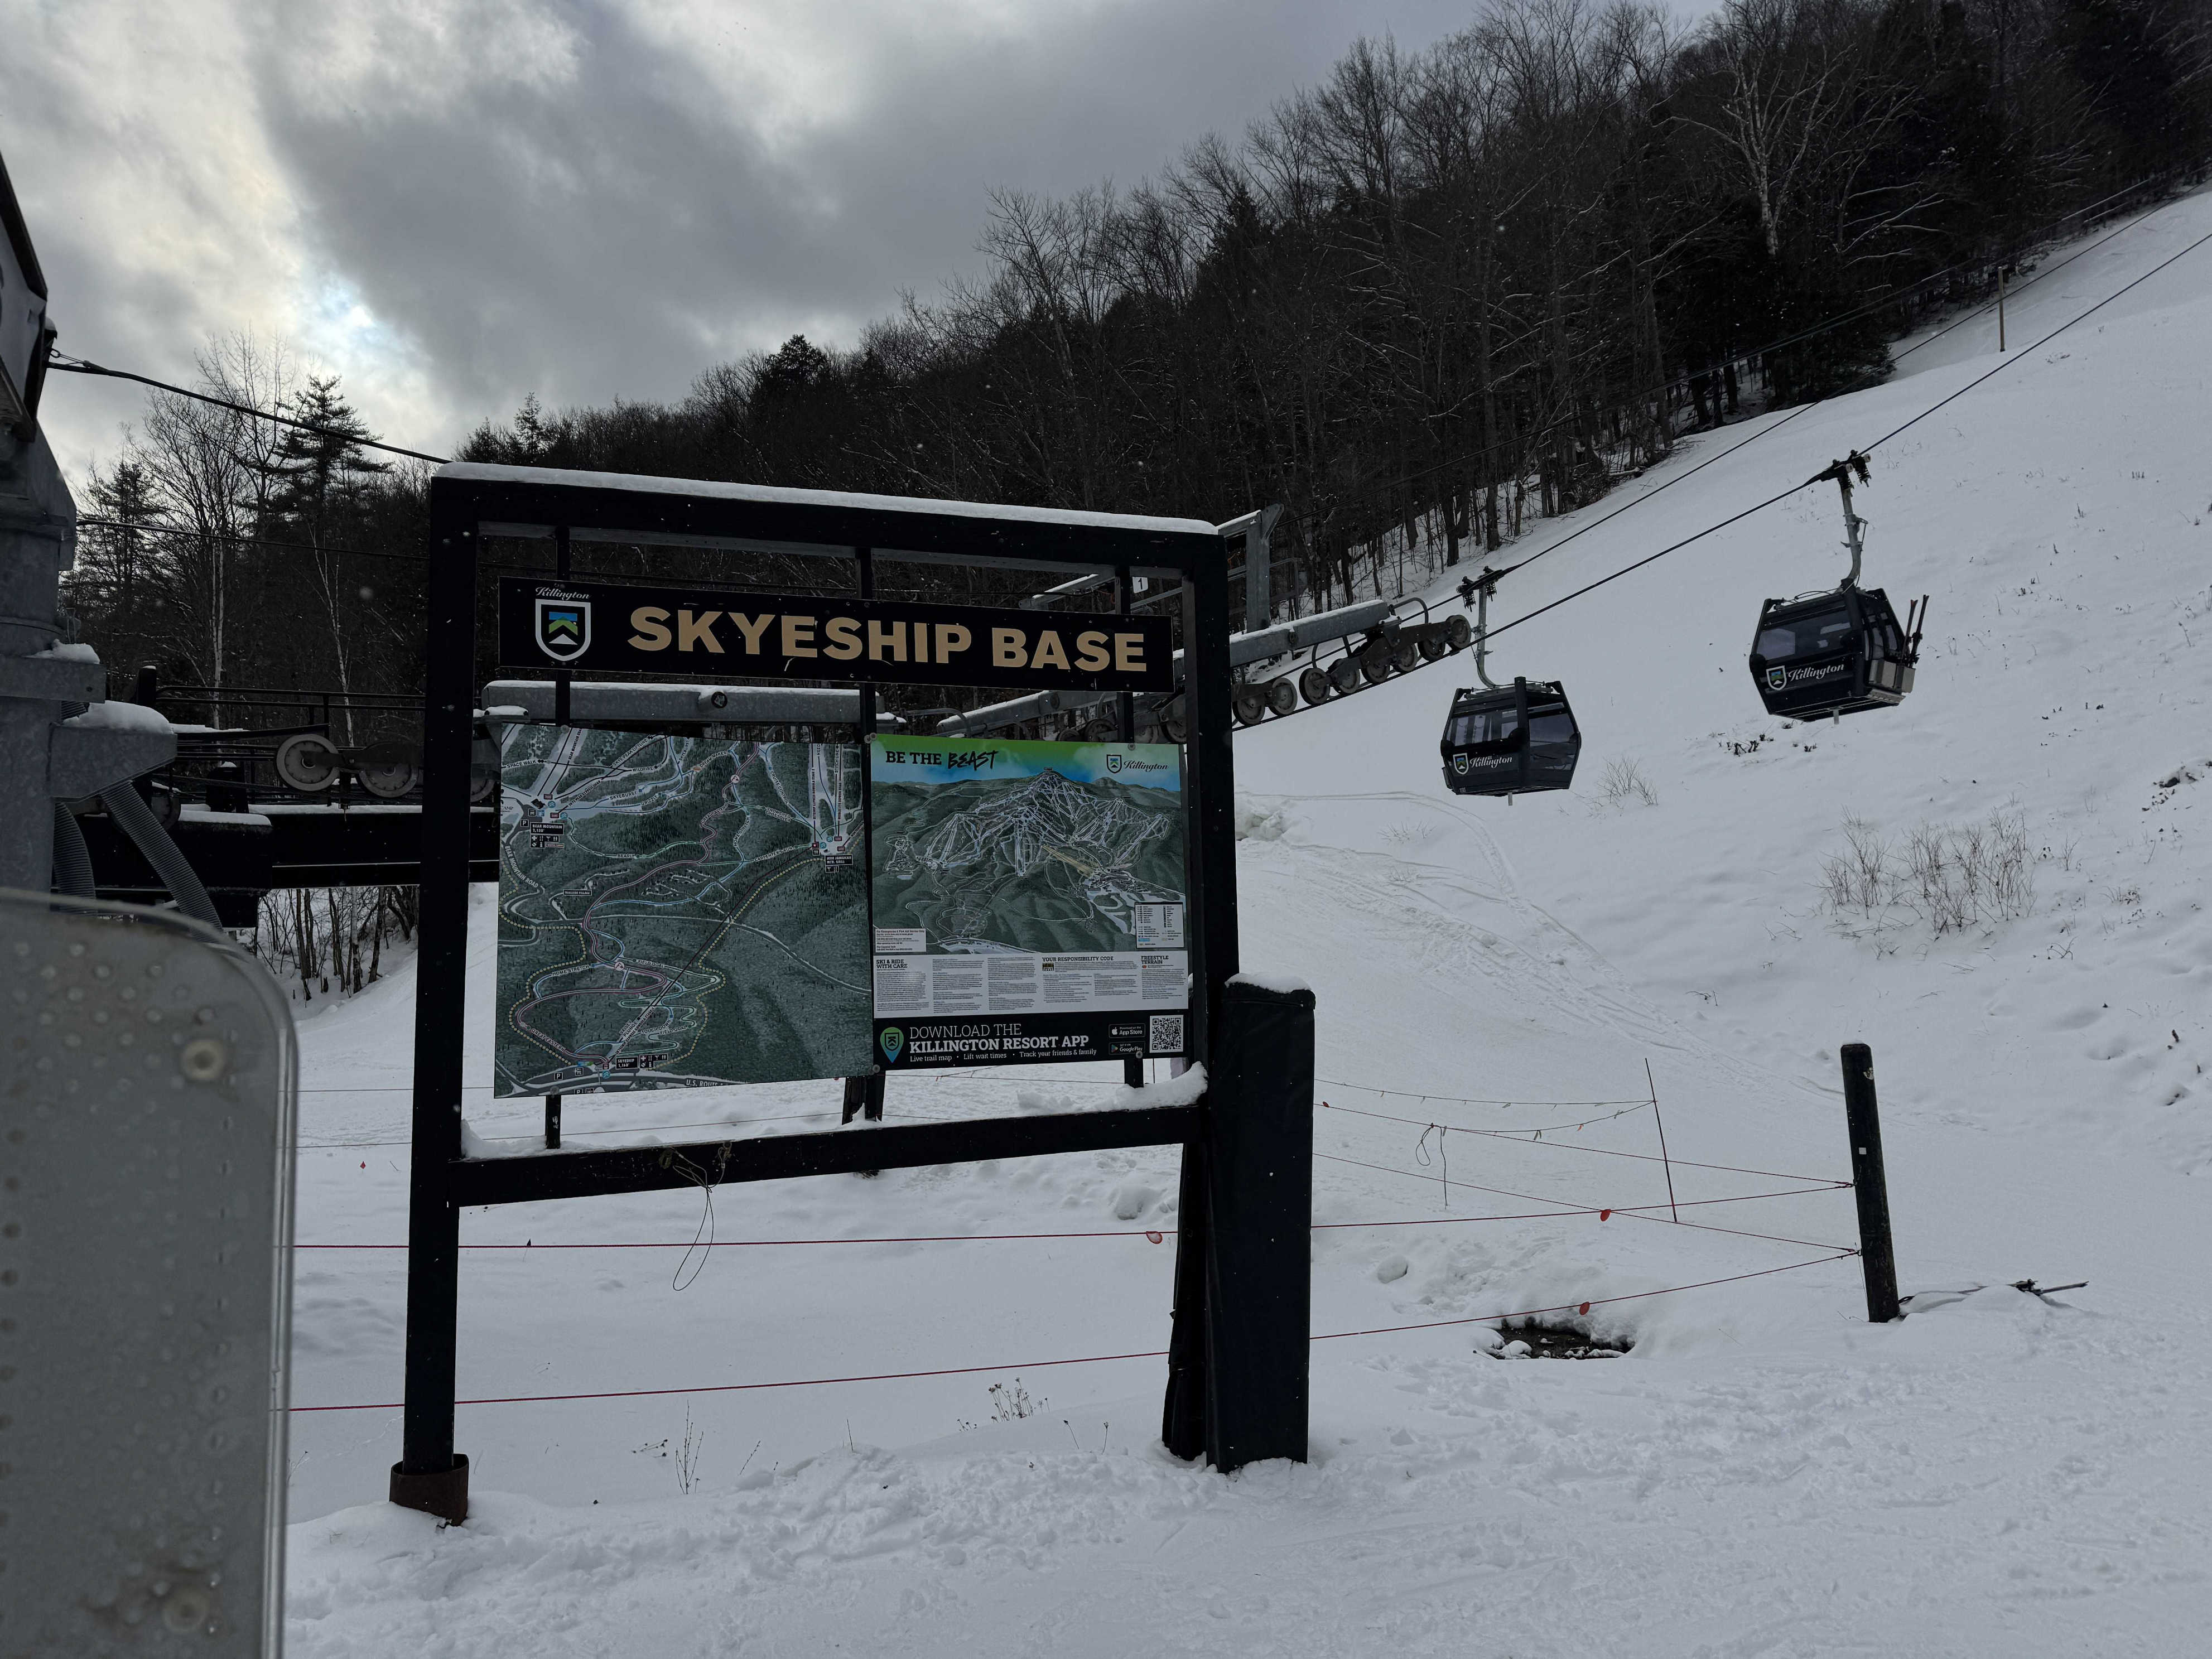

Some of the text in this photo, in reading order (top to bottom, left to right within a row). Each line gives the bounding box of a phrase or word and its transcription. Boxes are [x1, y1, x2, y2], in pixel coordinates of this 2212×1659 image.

[1138, 577, 1143, 590] 1
[536, 586, 590, 600] Killington
[627, 606, 1147, 672] SKYESHIP BASE
[1787, 664, 1845, 682] Killington
[700, 756, 712, 768] DREAM
[885, 750, 999, 771] BE THE BEAST
[1124, 760, 1168, 772] Killington
[1469, 756, 1512, 769] Killington
[770, 771, 789, 804] CRUISE CONTROL
[610, 792, 637, 800] SKYEBURST
[504, 845, 538, 888] BEAR MOUNTAIN ROAD
[623, 1022, 637, 1036] PLUNGE
[909, 1024, 1021, 1039] DOWNLOAD THE
[531, 1028, 566, 1052] GREAT EASTERN
[909, 1035, 1089, 1053] KILLINGTON RESORT APP
